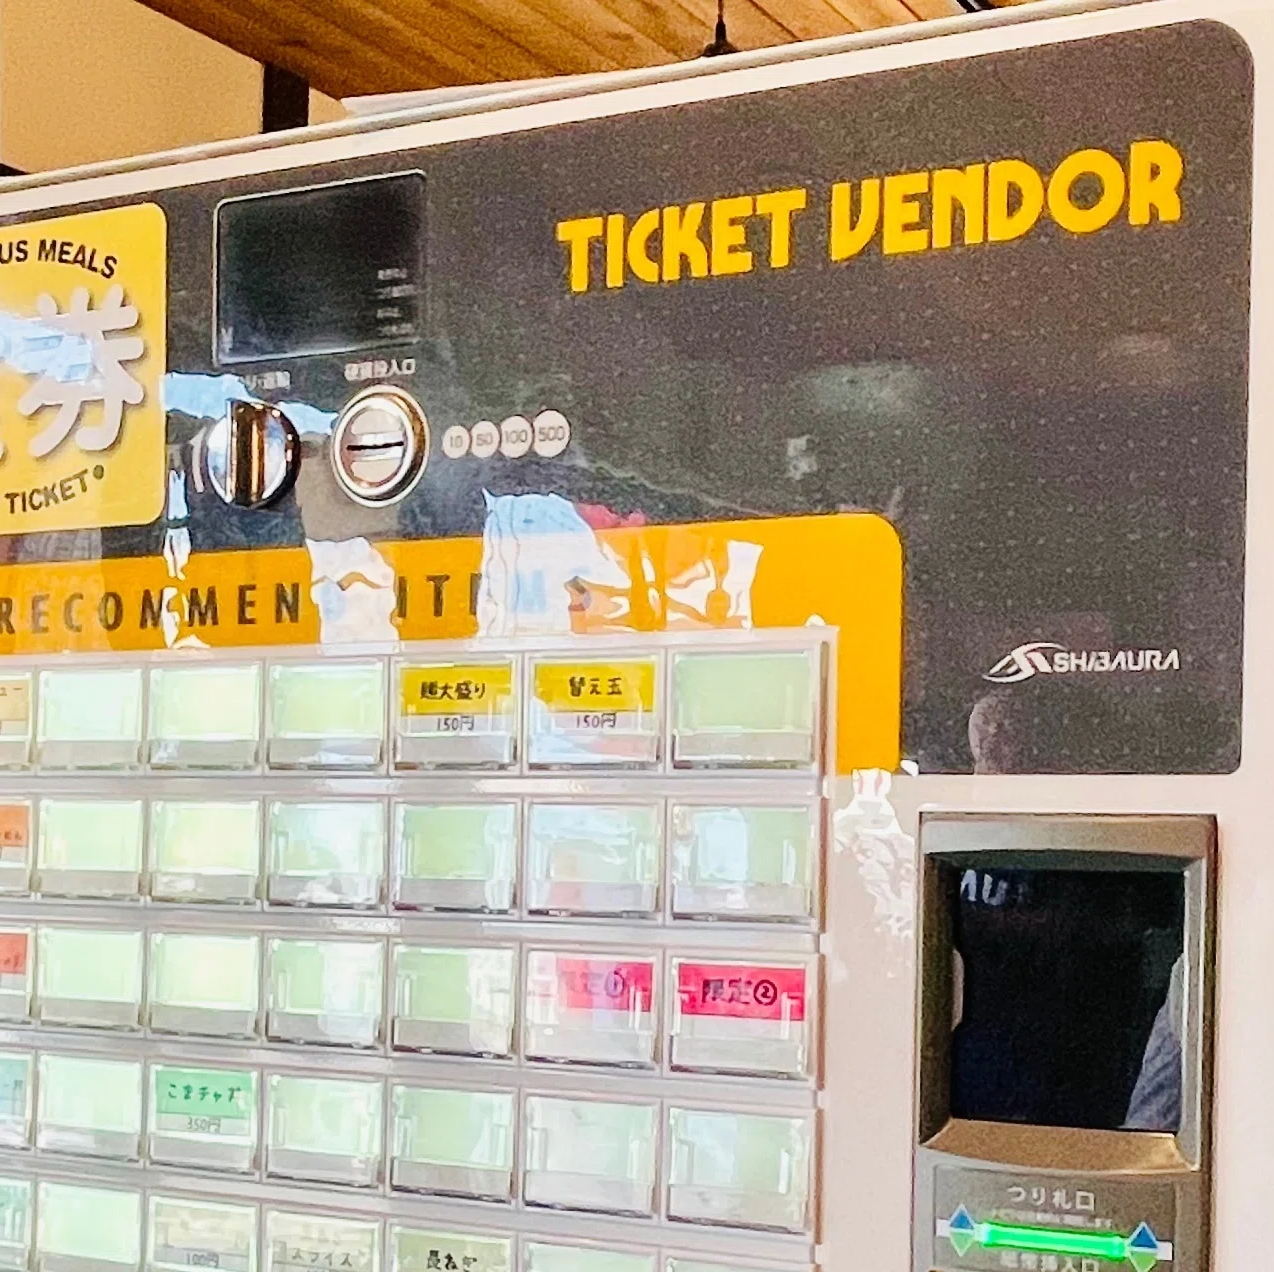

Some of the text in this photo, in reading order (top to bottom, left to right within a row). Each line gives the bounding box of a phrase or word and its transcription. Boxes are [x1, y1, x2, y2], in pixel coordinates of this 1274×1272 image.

[556, 139, 1184, 292] TICKET VENDOR
[38, 239, 117, 279] MEALS
[449, 434, 464, 447] 10
[504, 429, 528, 444] 100
[538, 426, 566, 442] 500
[6, 468, 91, 514] TICKET
[1053, 649, 1180, 673] SHIBAURA
[569, 676, 623, 698] 替え玉
[438, 715, 475, 731] 150円
[576, 712, 617, 729] 150円
[1007, 1186, 1095, 1212] つり札口
